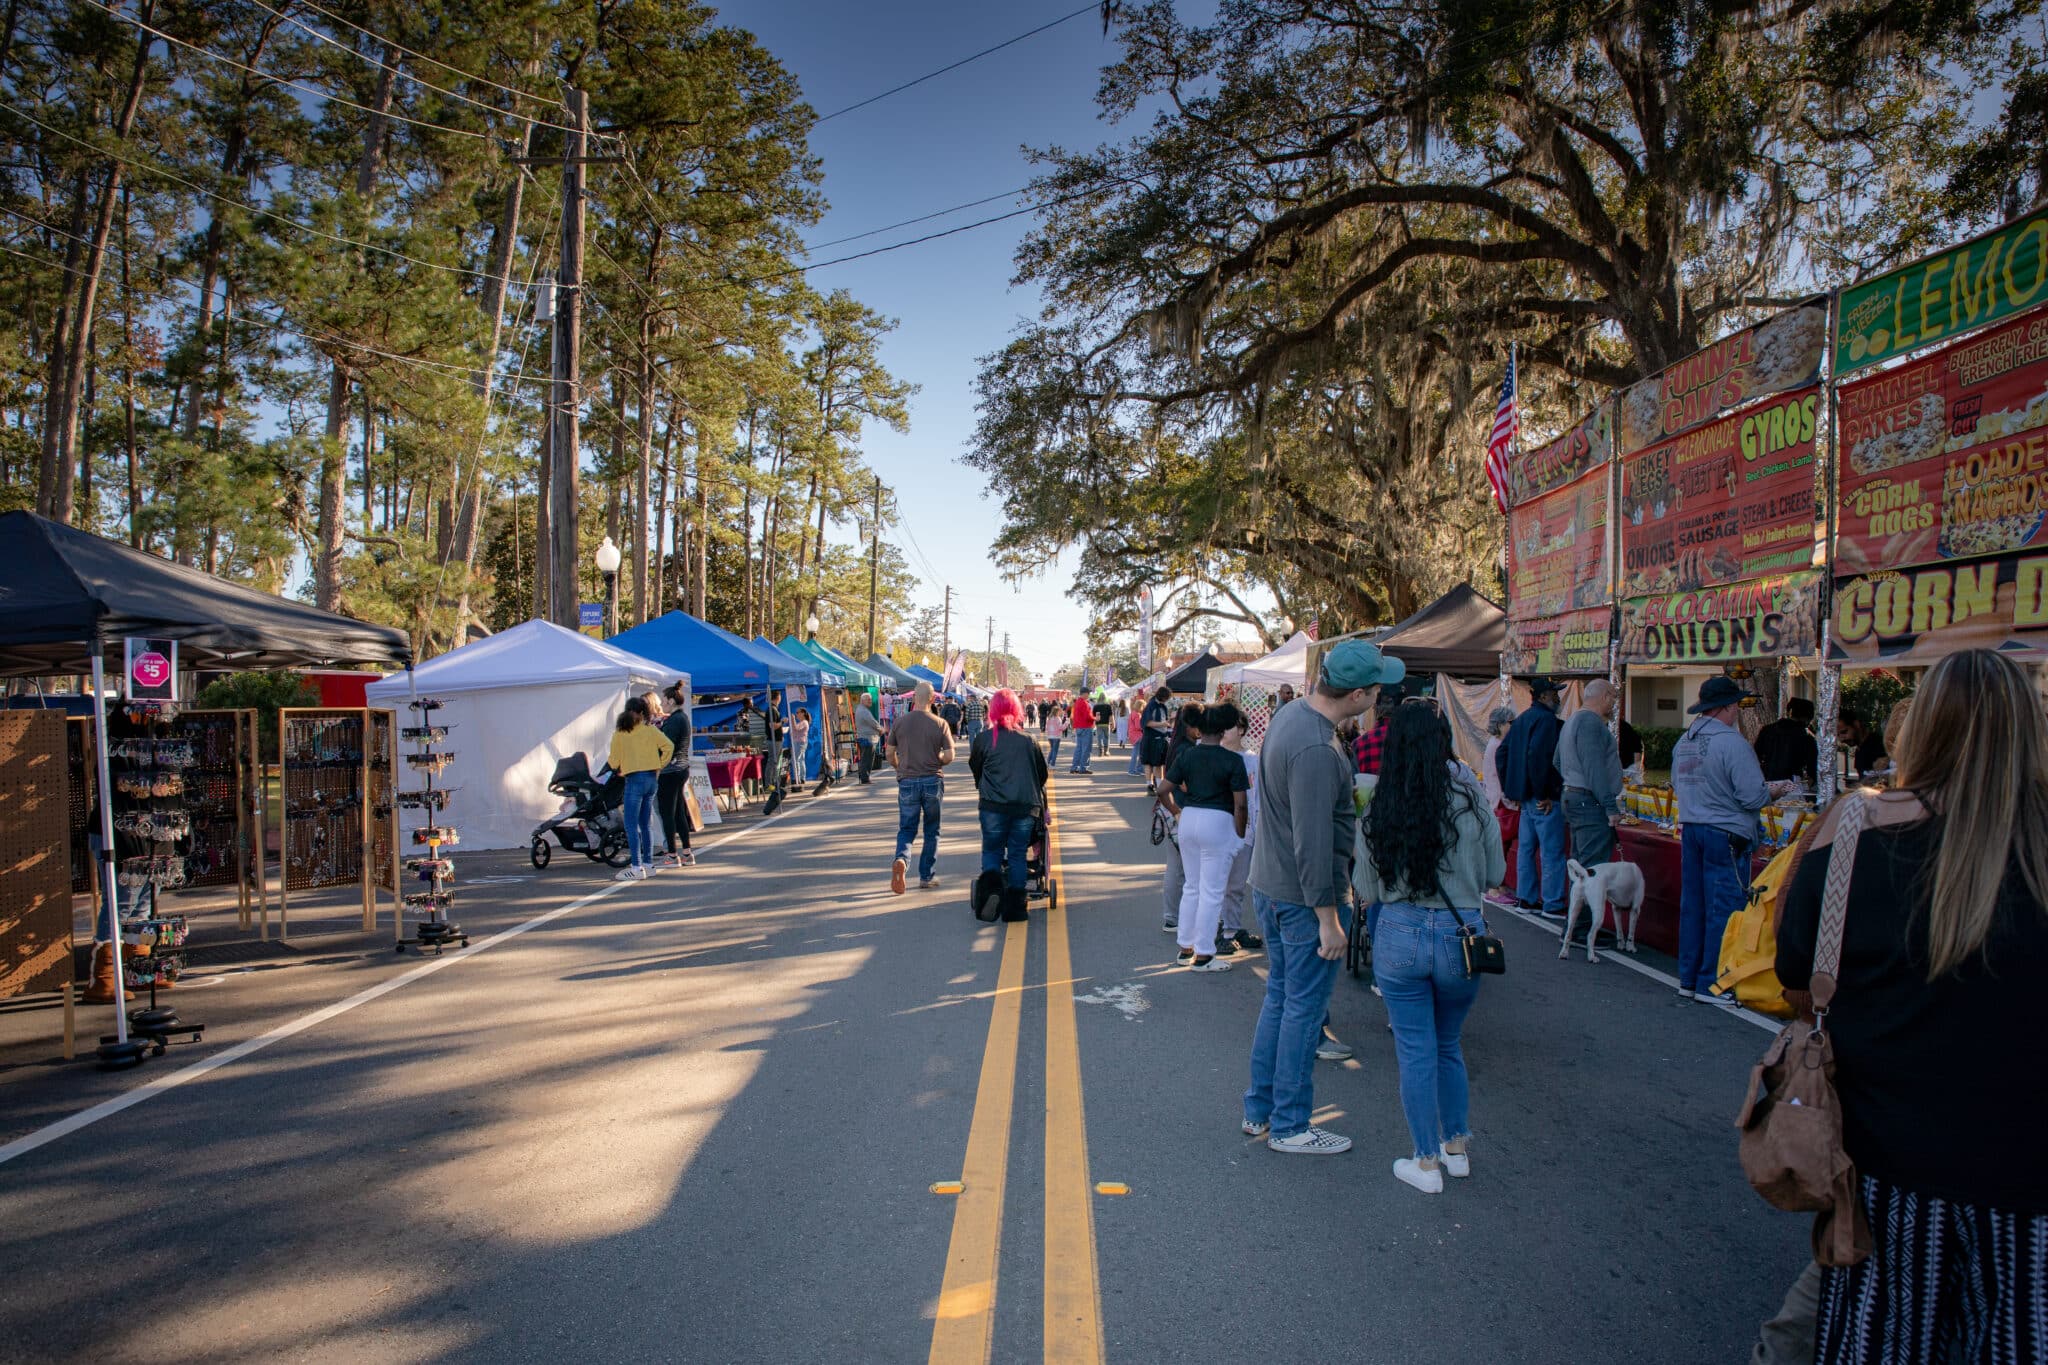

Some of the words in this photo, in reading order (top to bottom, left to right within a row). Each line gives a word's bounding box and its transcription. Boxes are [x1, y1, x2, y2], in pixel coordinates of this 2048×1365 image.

[1894, 219, 2048, 351] LEMO
[1840, 294, 1891, 348] SQUEEZED
[1848, 290, 1880, 326] FRESH
[1661, 329, 1753, 403] FUNNEL
[1949, 326, 2024, 372] BUTTERFLY
[1961, 350, 2014, 386] FRENCH
[1662, 368, 1745, 435] CAKES
[1844, 364, 1938, 418] FUNNEL
[1686, 418, 1736, 462] LEMONADE
[1741, 394, 1817, 461] GYROS
[1844, 400, 1923, 445] CAKES
[1952, 416, 1978, 437] CUT
[1626, 446, 1672, 483] TURKEY
[1792, 453, 1813, 468] Lamb
[1780, 489, 1812, 515] CHEESE
[1855, 479, 1920, 517] CORN
[1954, 471, 2048, 527] NACHOS
[1679, 520, 1739, 546] SAUSAGE
[1868, 502, 1935, 539] DOGS
[1627, 541, 1675, 570] ONIONS
[1646, 578, 1784, 627] BLOOMIN'
[1839, 561, 1999, 642] CORN
[1644, 612, 1784, 660] ONIONS
[144, 664, 160, 678] $5
